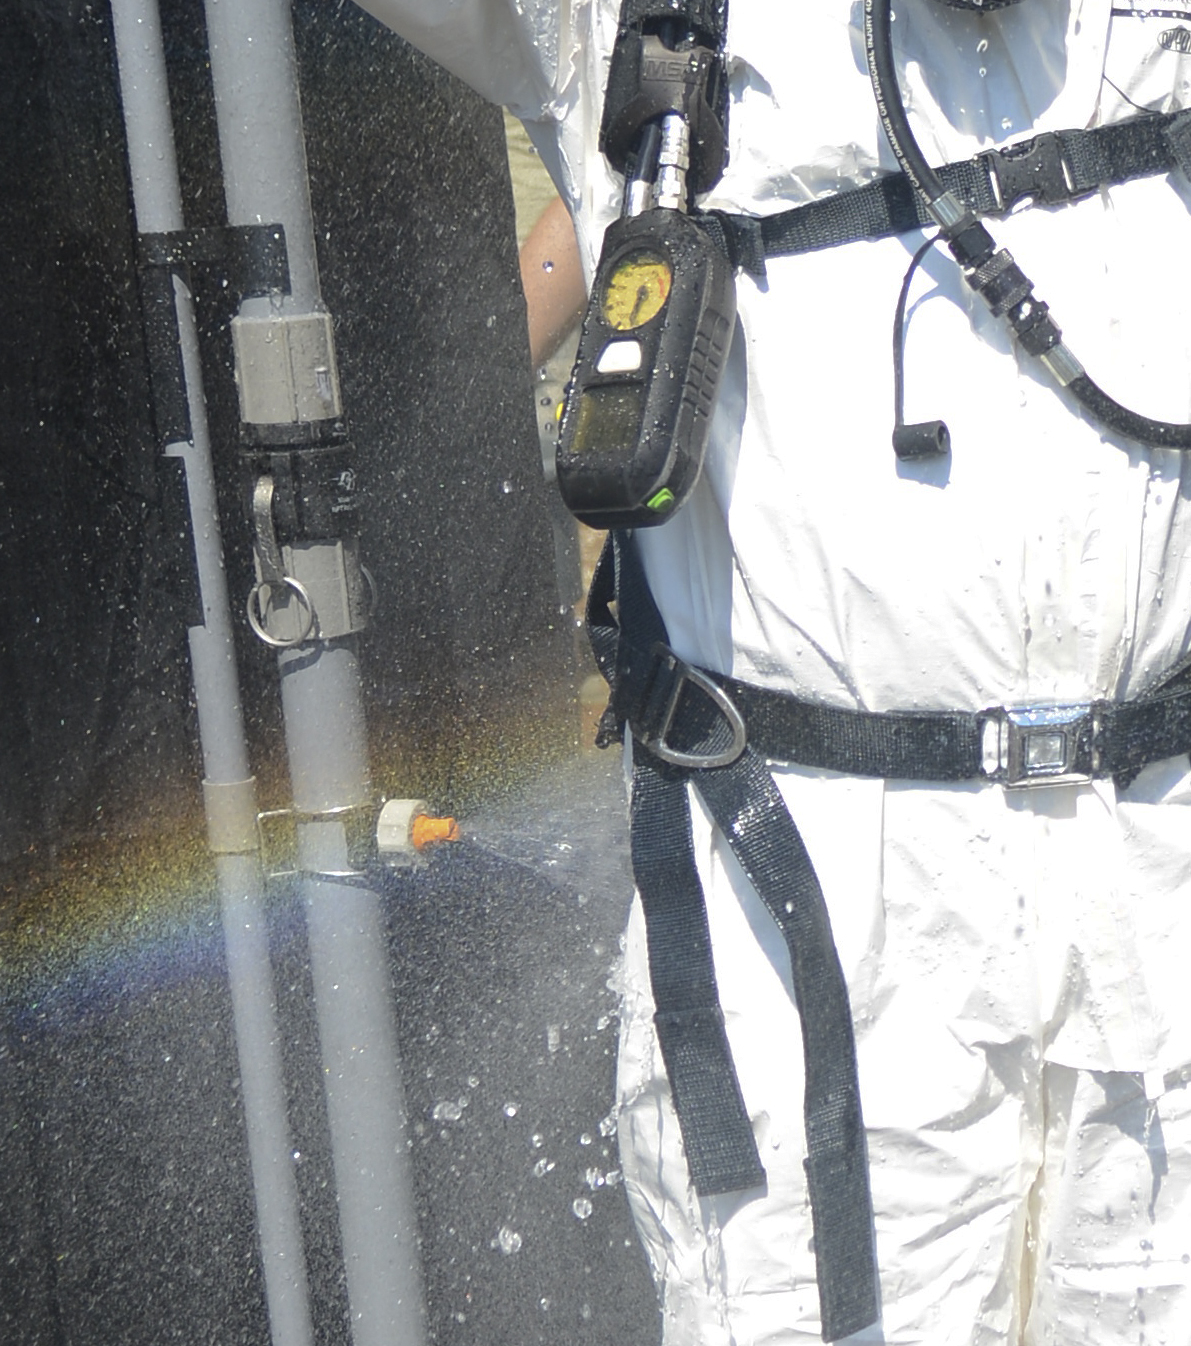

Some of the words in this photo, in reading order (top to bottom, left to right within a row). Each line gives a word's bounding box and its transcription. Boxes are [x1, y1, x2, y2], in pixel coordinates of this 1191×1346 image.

[646, 60, 698, 79] MS
[868, 50, 884, 101] PERSONAL
[879, 101, 888, 117] OR
[883, 117, 904, 158] DAMAGE
[900, 157, 920, 188] CAUSE
